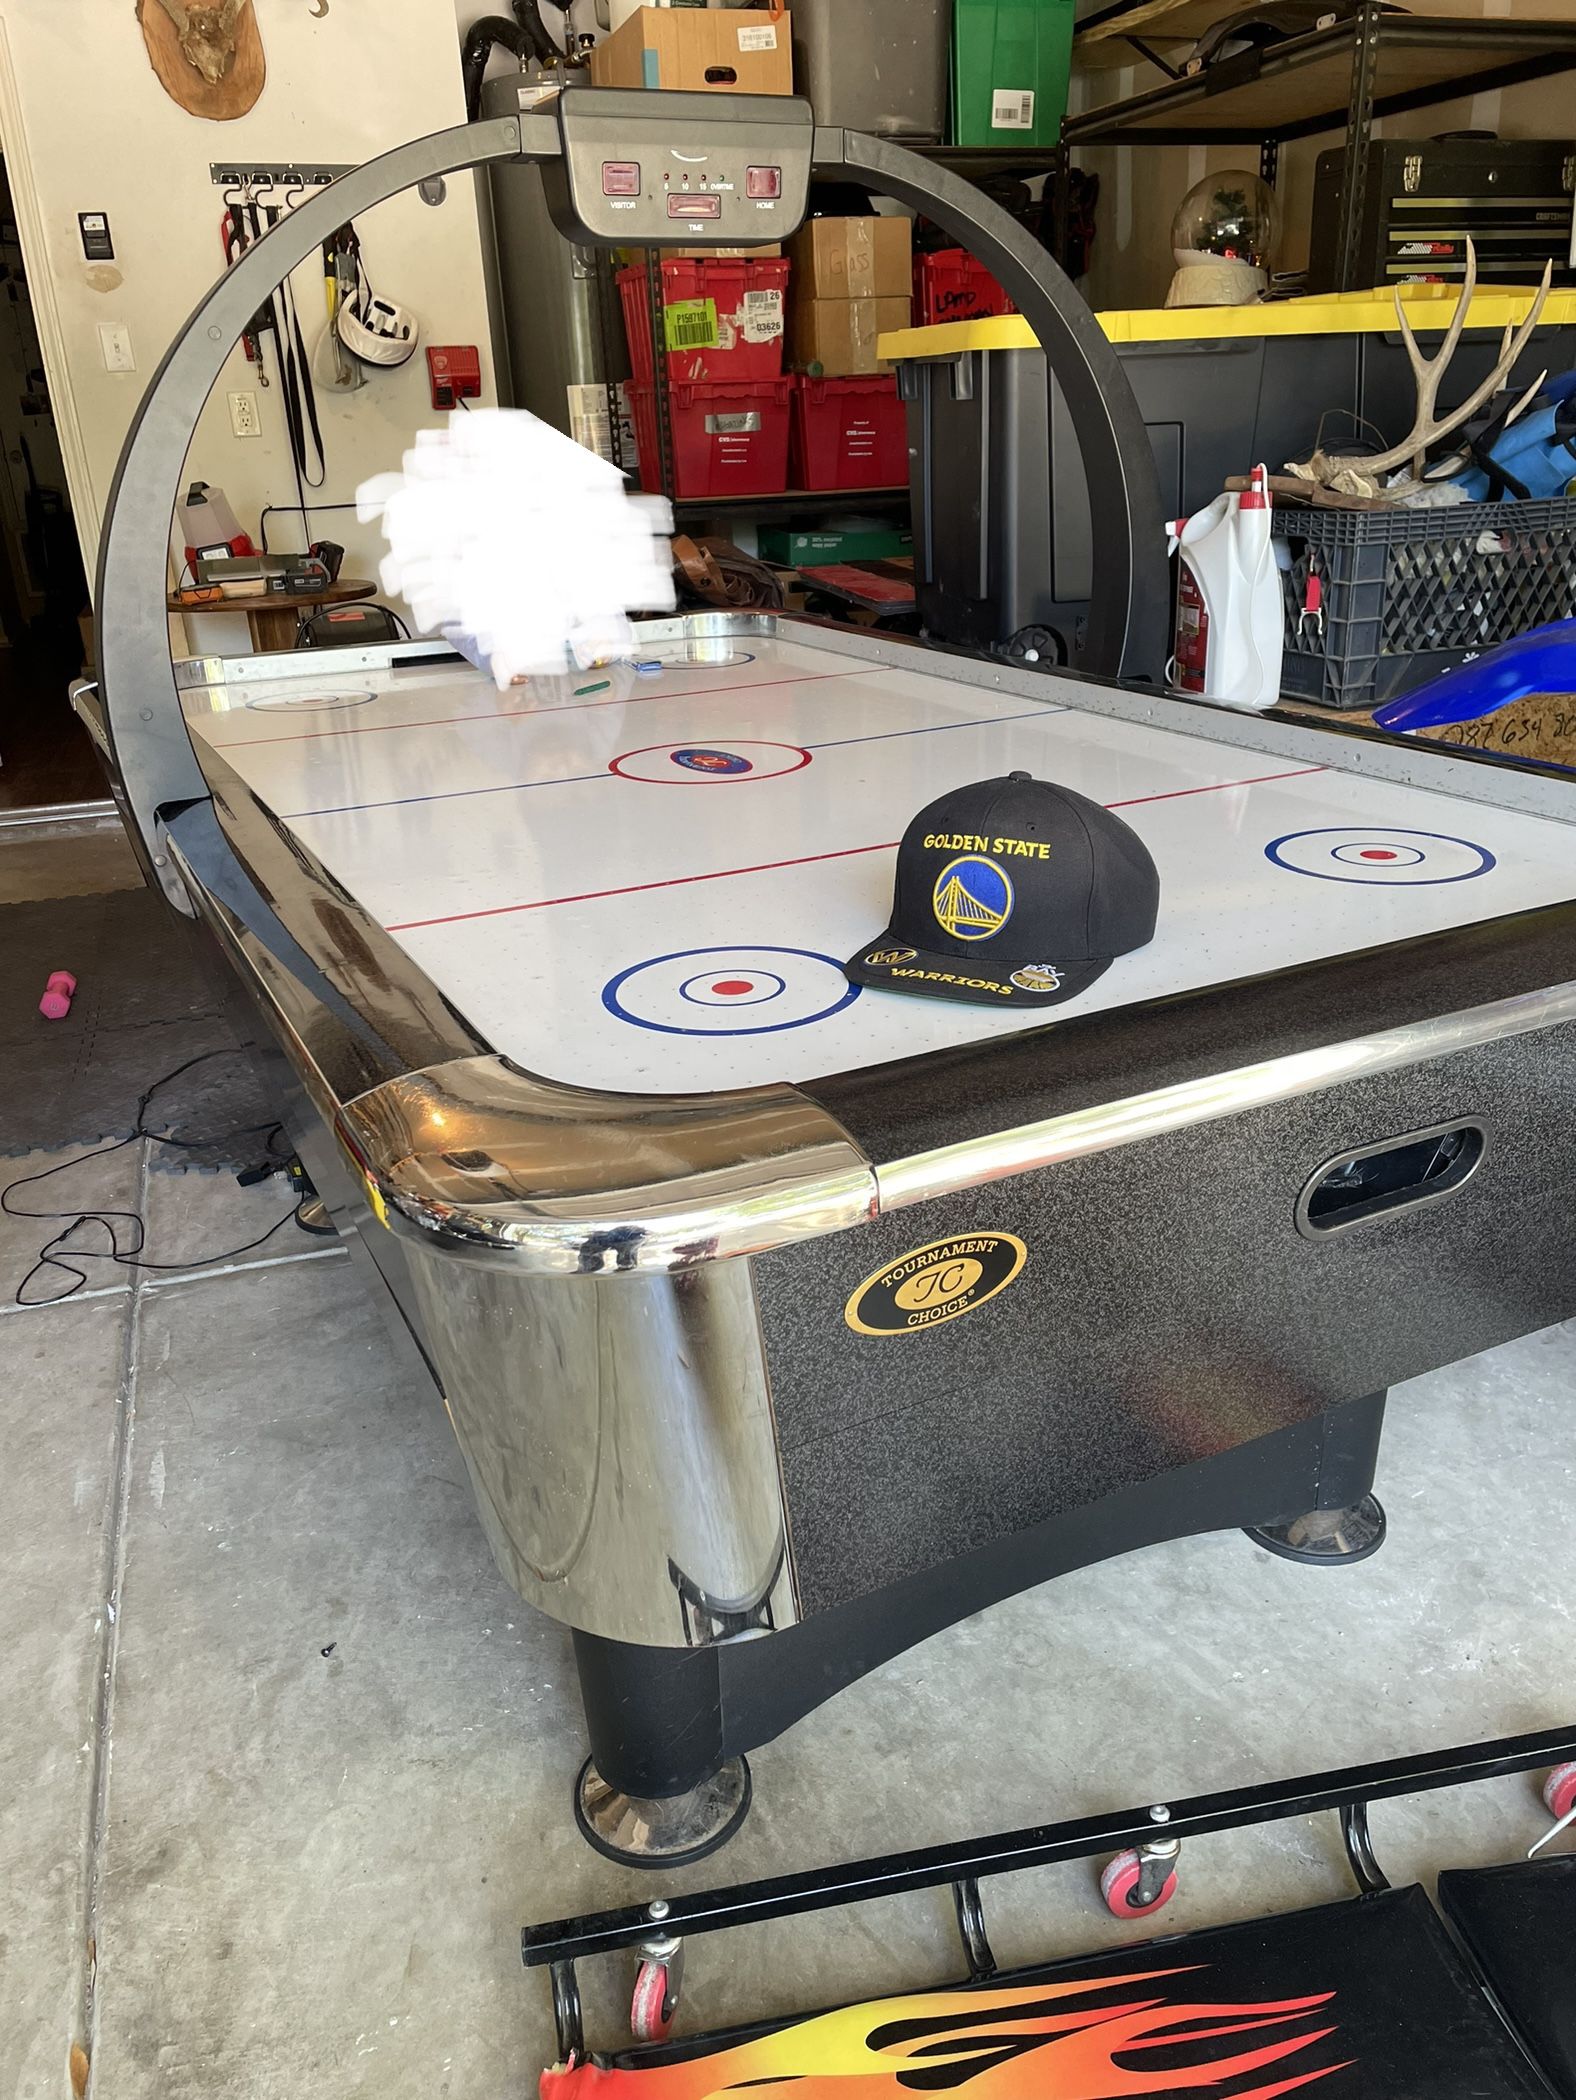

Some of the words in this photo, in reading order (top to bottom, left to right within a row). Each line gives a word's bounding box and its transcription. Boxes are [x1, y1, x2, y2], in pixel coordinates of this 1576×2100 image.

[610, 201, 636, 209] VISITOR
[688, 224, 704, 232] TIME
[770, 292, 780, 300] 26
[923, 834, 989, 852] GOLDEN
[992, 837, 1051, 859] STATE
[890, 967, 1014, 995] WARRIORS
[881, 1240, 999, 1288] TOURNAMENT
